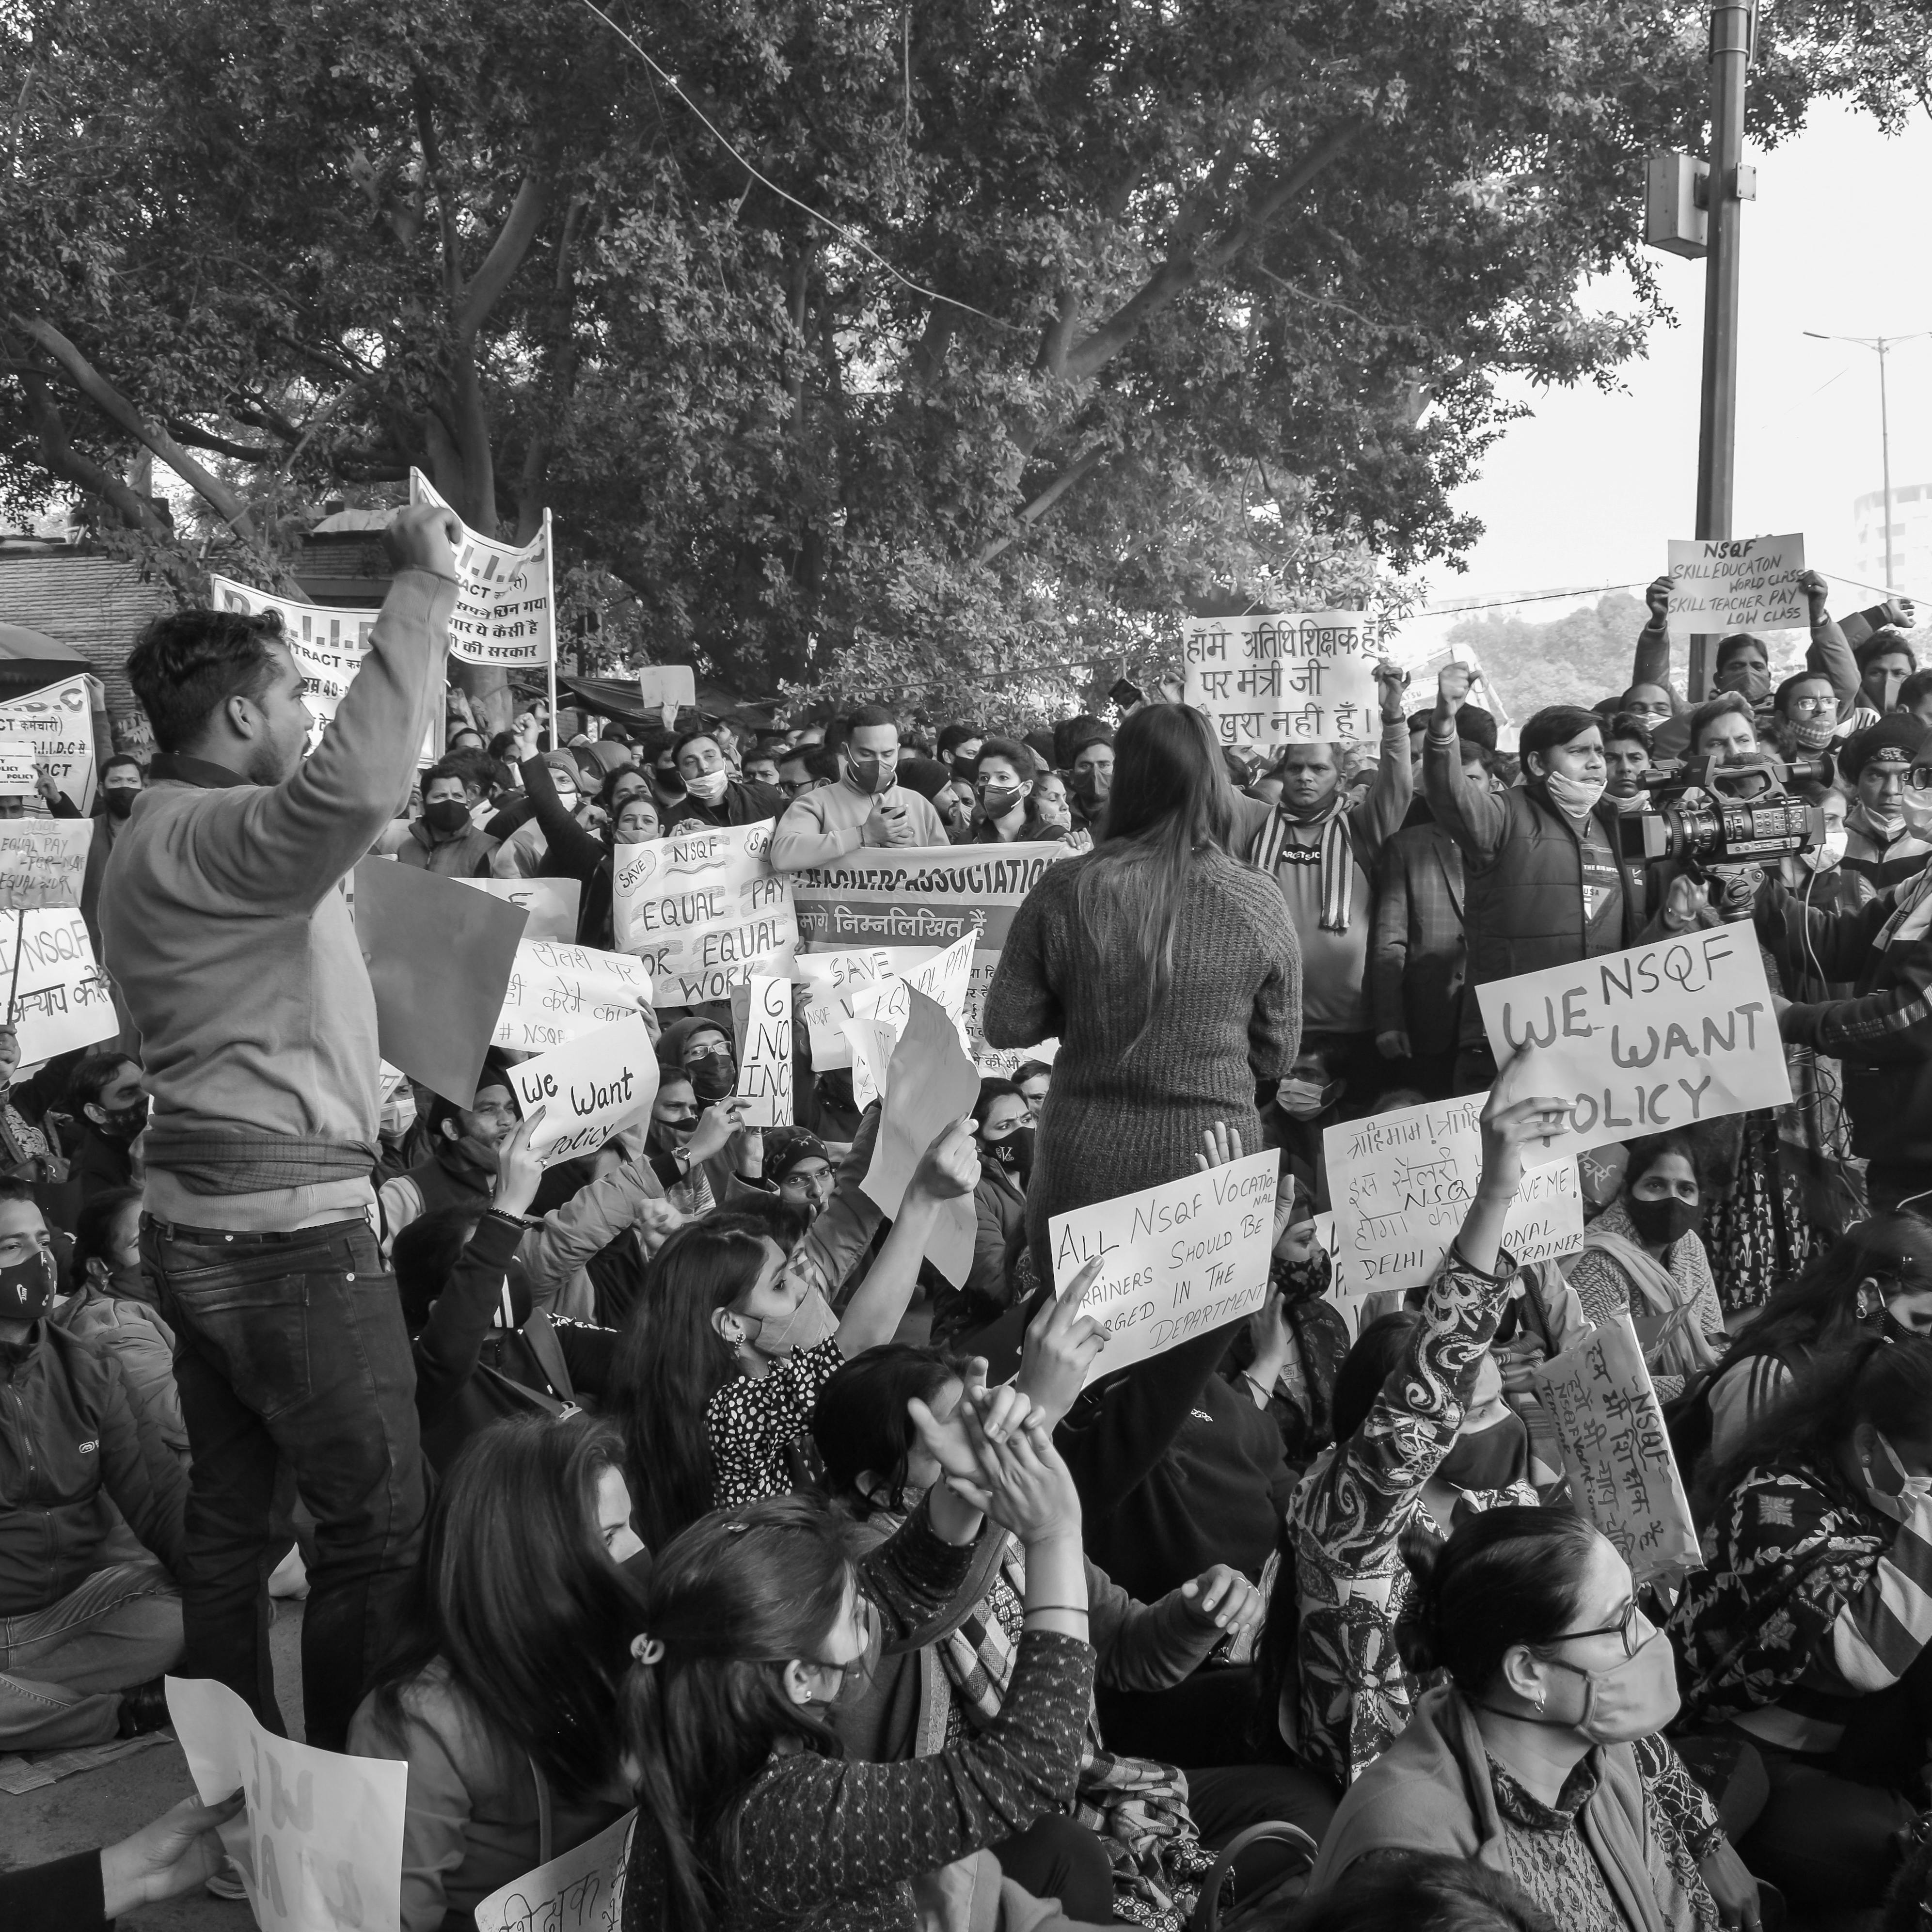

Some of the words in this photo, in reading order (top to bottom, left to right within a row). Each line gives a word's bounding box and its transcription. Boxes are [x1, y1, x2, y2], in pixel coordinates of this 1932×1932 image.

[1704, 539, 1757, 559] NSQF
[1671, 563, 1711, 580] SKILL
[1729, 578, 1765, 593] WORLD
[1768, 569, 1806, 586] CLASS
[523, 597, 546, 612] गया
[1668, 597, 1707, 614] SKILL
[1709, 594, 1765, 612] TEACHER
[1769, 588, 1799, 605] PAY
[1726, 609, 1758, 625] LOW
[1763, 607, 1802, 623] CLASS
[476, 622, 489, 636] ये
[493, 622, 525, 638] कैसी
[526, 619, 538, 634] है
[1241, 621, 1299, 659] अतिथि
[1298, 618, 1358, 658] शिक्षक
[463, 641, 484, 655] की
[488, 645, 538, 657] सरकार
[1200, 670, 1233, 699] पर
[1237, 660, 1284, 698] मंत्री
[1289, 658, 1331, 696] जी
[1270, 702, 1325, 738] नहीं
[1, 838, 37, 855] EQUAL
[44, 837, 68, 858] PAY
[619, 860, 646, 888] SAVE
[673, 837, 717, 863] NSQF
[750, 832, 772, 854] SA
[905, 858, 1061, 894] ASSOCIATIO
[1584, 888, 1599, 896] USA
[643, 892, 724, 931] EQUAL
[752, 876, 784, 909] PAY
[834, 904, 965, 938] निम्नलिखित
[21, 919, 88, 972] NSQF
[642, 948, 672, 977] OR
[703, 919, 785, 968] EQUAL
[944, 938, 973, 981] PAY
[603, 960, 640, 985] पर
[679, 963, 754, 1002] WORK
[830, 951, 894, 989] SAVE
[1599, 934, 1734, 1006] NSQF
[764, 979, 784, 1017] G
[523, 1023, 566, 1045] NSQF
[807, 1007, 831, 1027] NSQF
[1611, 1001, 1764, 1068] WANT
[751, 1019, 790, 1061] NO
[522, 1073, 558, 1104] We
[570, 1066, 634, 1116] Want
[1252, 1194, 1275, 1208] NAL
[1508, 1175, 1541, 1208] AVE
[1057, 1223, 1120, 1270] ALL
[1130, 1193, 1203, 1244] NSQF
[1511, 1233, 1583, 1262] TRAINER
[1081, 1266, 1153, 1309] RAINERS
[1168, 1231, 1232, 1269] SHOULD
[1240, 1214, 1264, 1238] BE
[1359, 1249, 1424, 1281] DELHI
[1103, 1301, 1155, 1332] RGED
[1172, 1281, 1191, 1309] IN
[1205, 1262, 1235, 1292] THE
[1555, 1382, 1580, 1438] NSQF
[1583, 1417, 1608, 1453] भी
